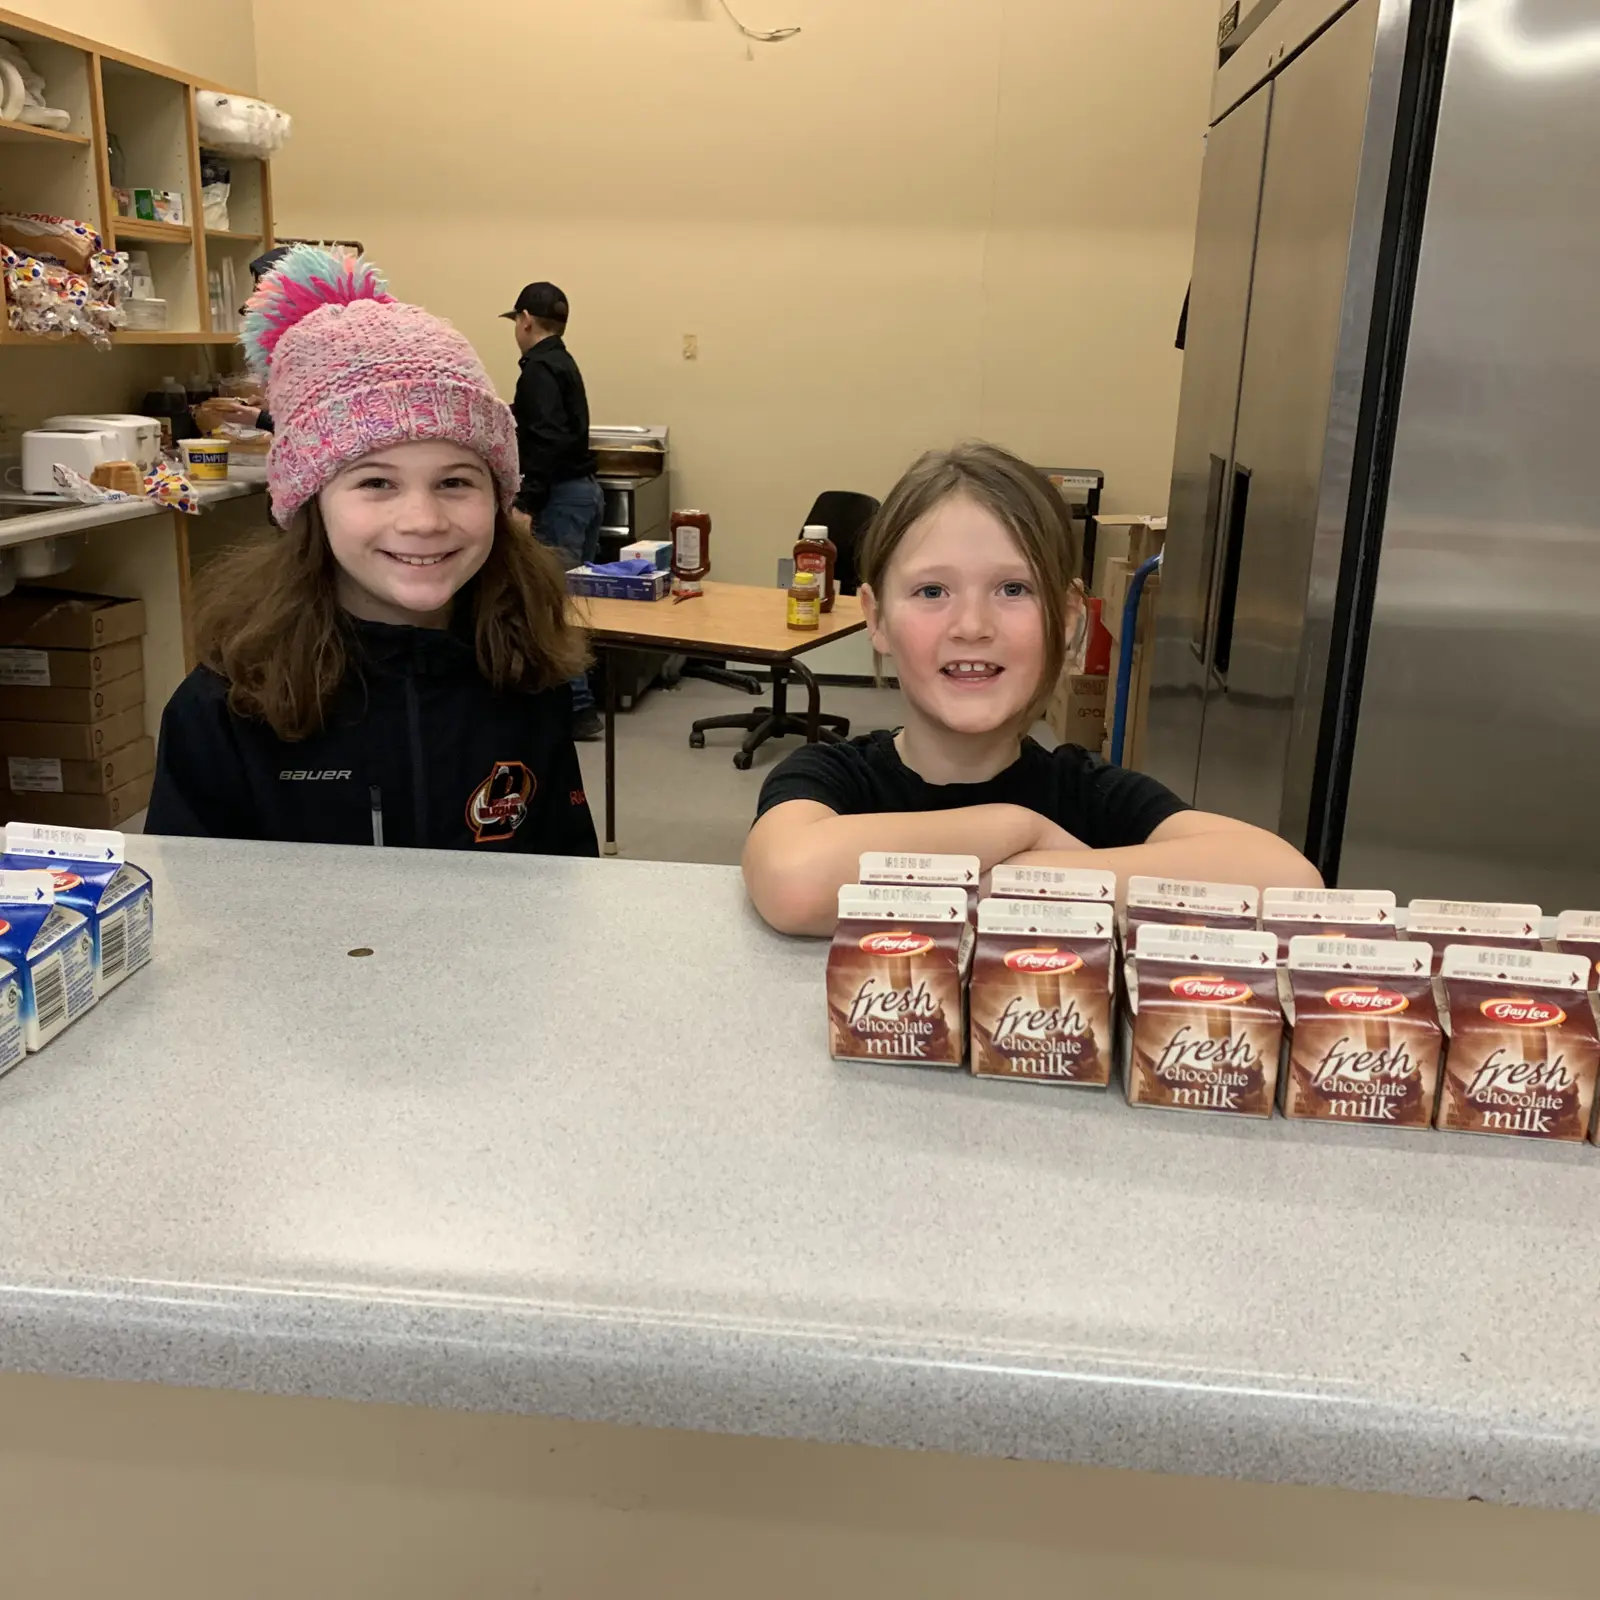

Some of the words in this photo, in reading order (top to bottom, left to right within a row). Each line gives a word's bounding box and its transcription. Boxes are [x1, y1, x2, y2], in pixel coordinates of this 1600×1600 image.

[1183, 982, 1213, 996] Gay
[1214, 983, 1237, 996] Lea
[1339, 993, 1370, 1007] Gay
[1371, 995, 1393, 1007] Lea
[848, 979, 936, 1024] fresh
[1495, 1003, 1526, 1019] Gay
[1527, 1006, 1549, 1019] Lea
[856, 1018, 933, 1035] chocolate
[992, 996, 1085, 1043] fresh
[865, 1033, 926, 1057] milk
[1001, 1036, 1082, 1054] chocolate
[1156, 1025, 1255, 1071] fresh
[1009, 1052, 1075, 1077] milk
[1313, 1037, 1413, 1083] fresh
[1467, 1049, 1571, 1094] fresh
[1165, 1065, 1249, 1086] chocolate
[1321, 1076, 1408, 1097] chocolate
[1171, 1085, 1239, 1109] milk
[1328, 1096, 1397, 1120] milk
[1475, 1088, 1563, 1110] chocolate
[1481, 1107, 1552, 1133] milk
